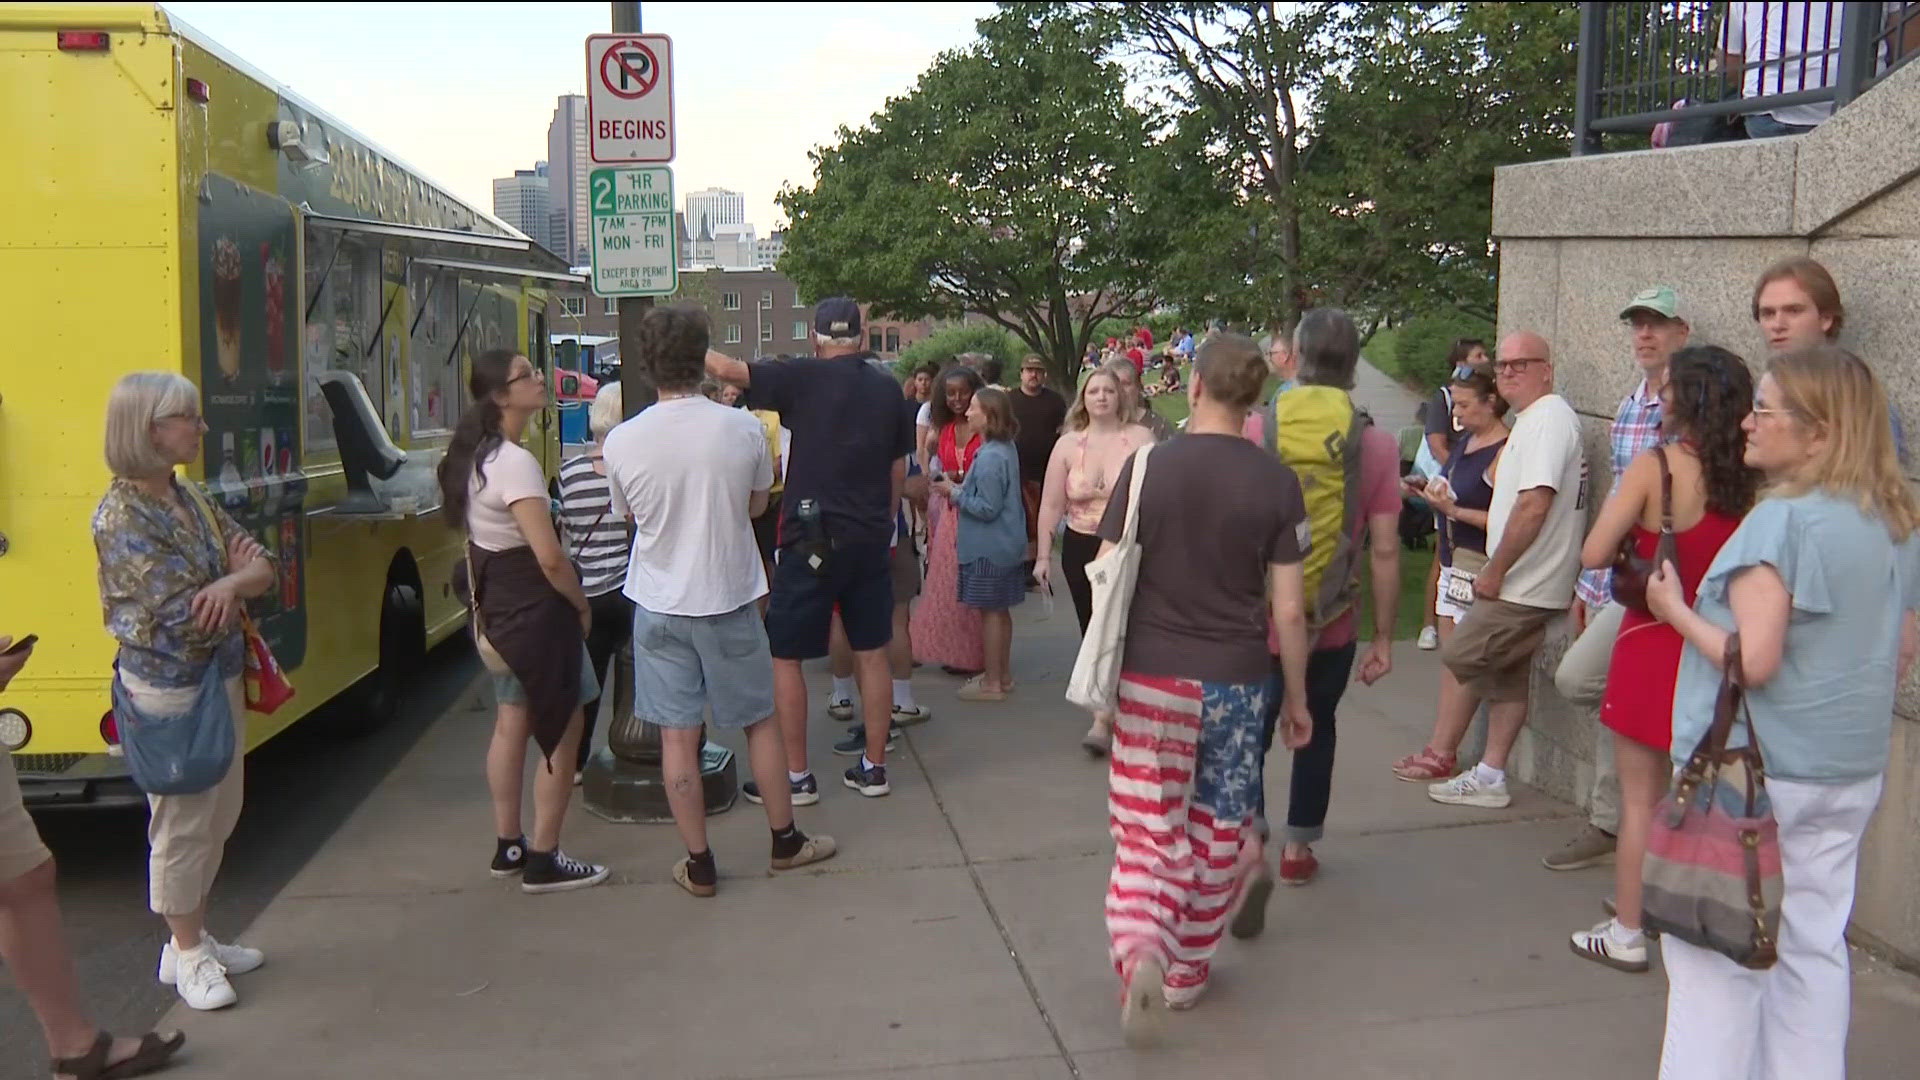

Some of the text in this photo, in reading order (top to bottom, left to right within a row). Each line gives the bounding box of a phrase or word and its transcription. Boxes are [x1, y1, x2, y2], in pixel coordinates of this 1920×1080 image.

[600, 120, 666, 140] BEGINS
[594, 173, 652, 210] 2 HR
[617, 192, 669, 210] PARKING
[641, 215, 667, 232] 7PM
[603, 236, 631, 250] MON
[644, 234, 665, 249] FRI
[601, 265, 668, 279] EXCEPT BY PERMIT
[642, 279, 652, 288] 28
